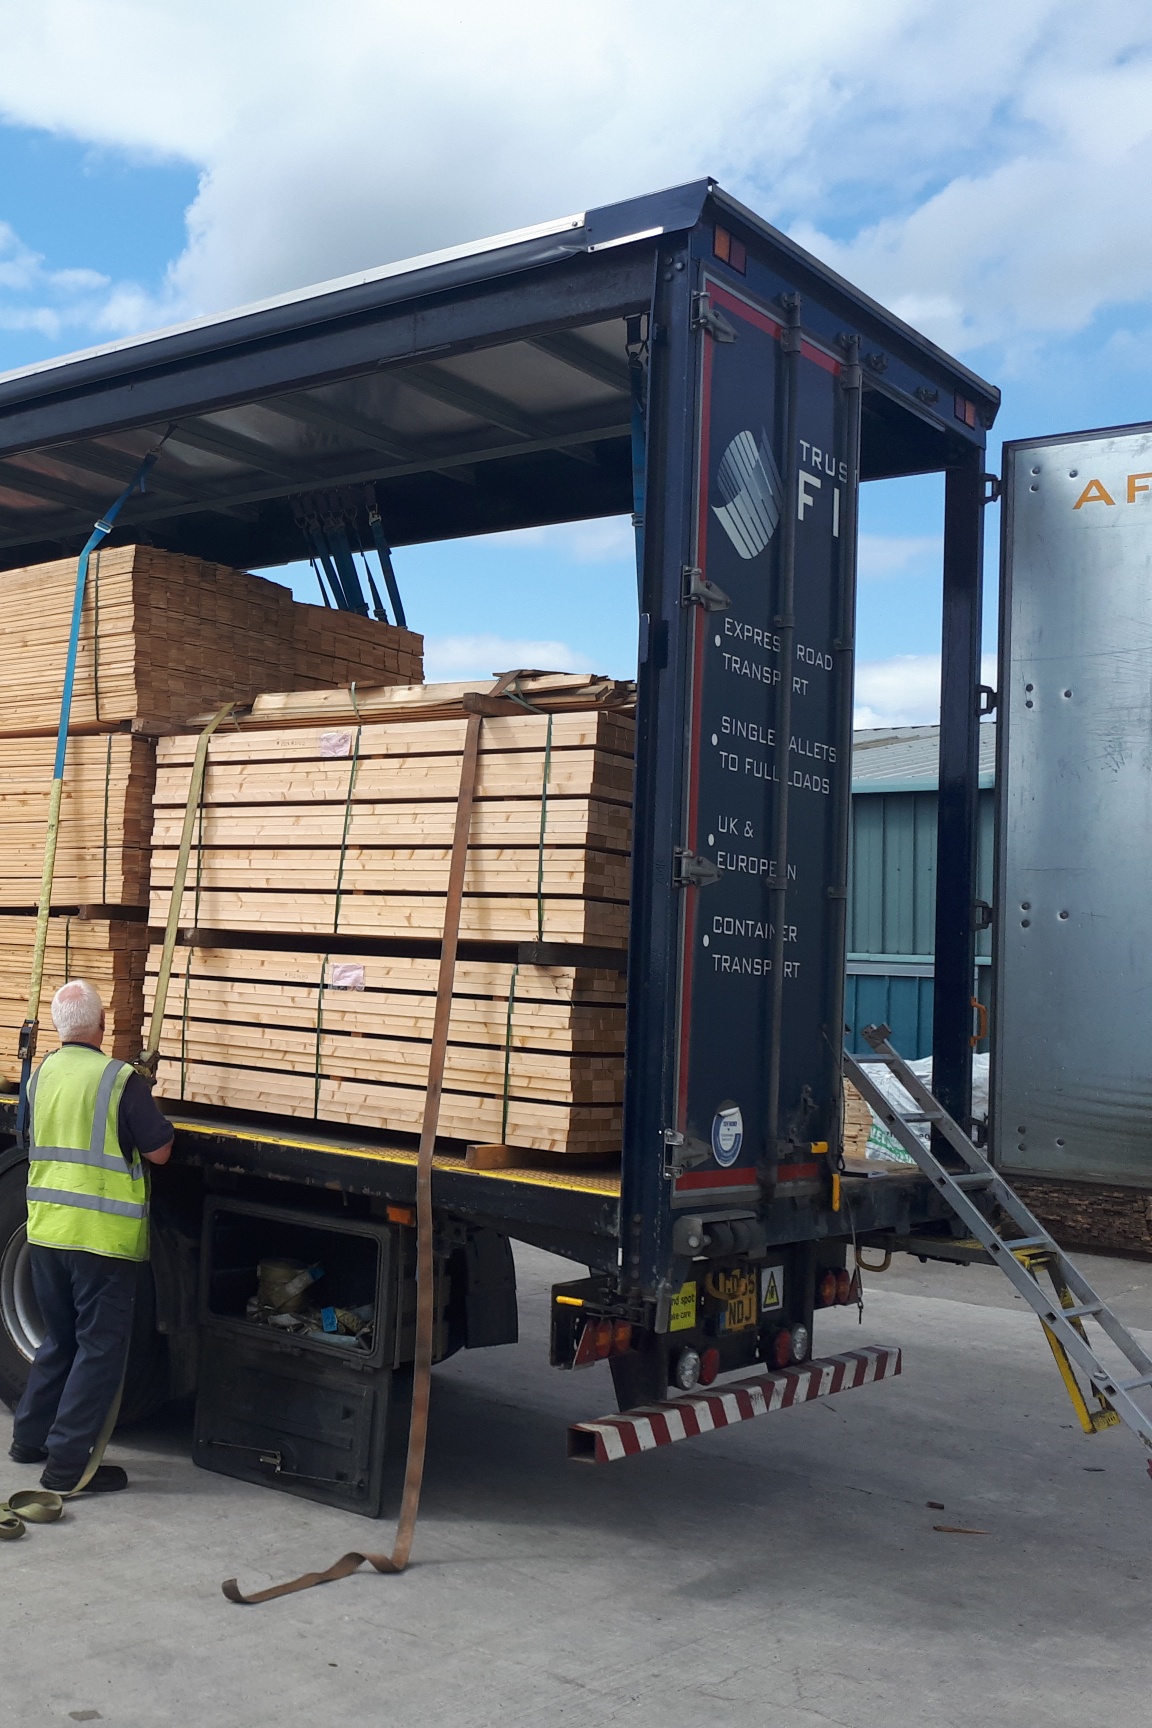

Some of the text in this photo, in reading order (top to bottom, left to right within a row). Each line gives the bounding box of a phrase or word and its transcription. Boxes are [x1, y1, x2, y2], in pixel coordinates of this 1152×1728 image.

[724, 617, 833, 671] EXPRES ROAD
[722, 652, 809, 696] TRANSPRT
[721, 715, 837, 763] SINGLE ALLETS
[719, 751, 738, 772] TO
[745, 758, 780, 783] FULL
[718, 814, 754, 838] UK &
[717, 851, 797, 880] EUROPEN
[712, 953, 801, 978] TRANSPRT
[728, 1298, 752, 1326] NDJ
